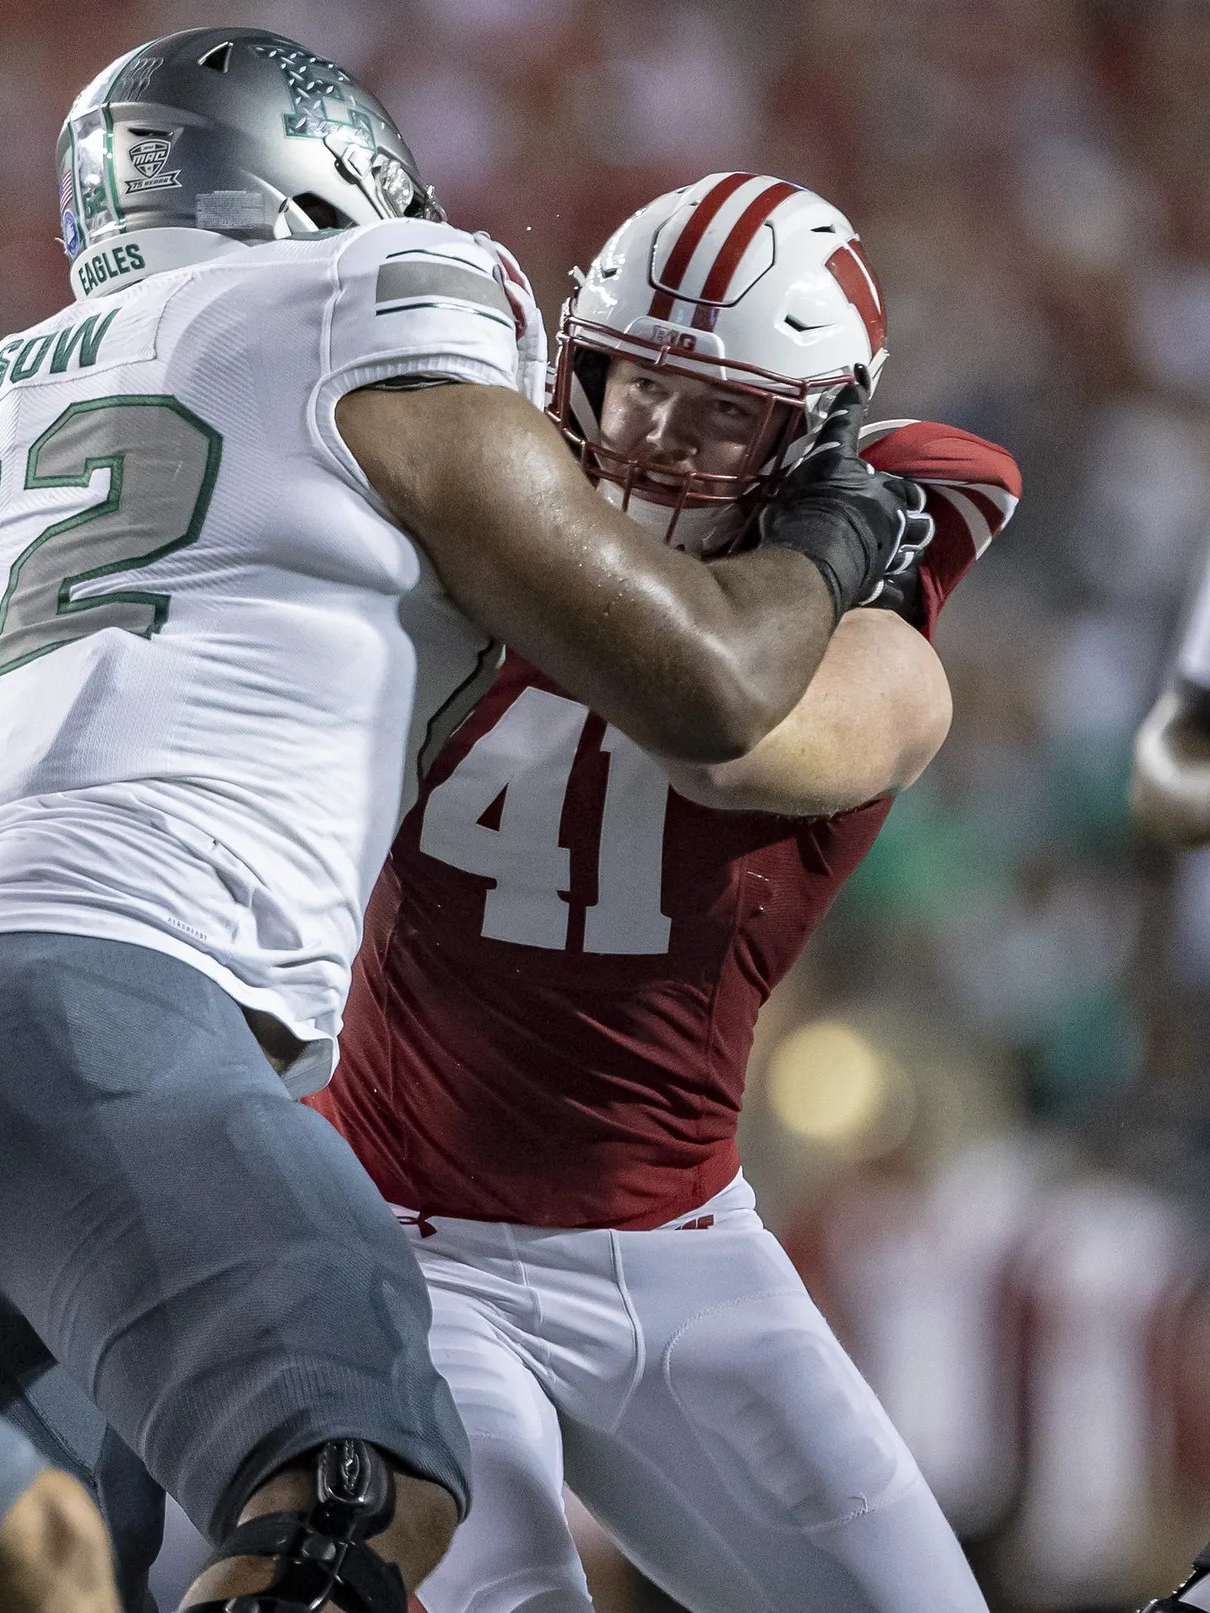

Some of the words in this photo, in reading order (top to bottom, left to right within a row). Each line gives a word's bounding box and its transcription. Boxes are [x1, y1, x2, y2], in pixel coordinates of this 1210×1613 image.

[132, 150, 167, 165] MAC
[78, 243, 146, 296] EAGLES
[419, 686, 672, 955] 41
